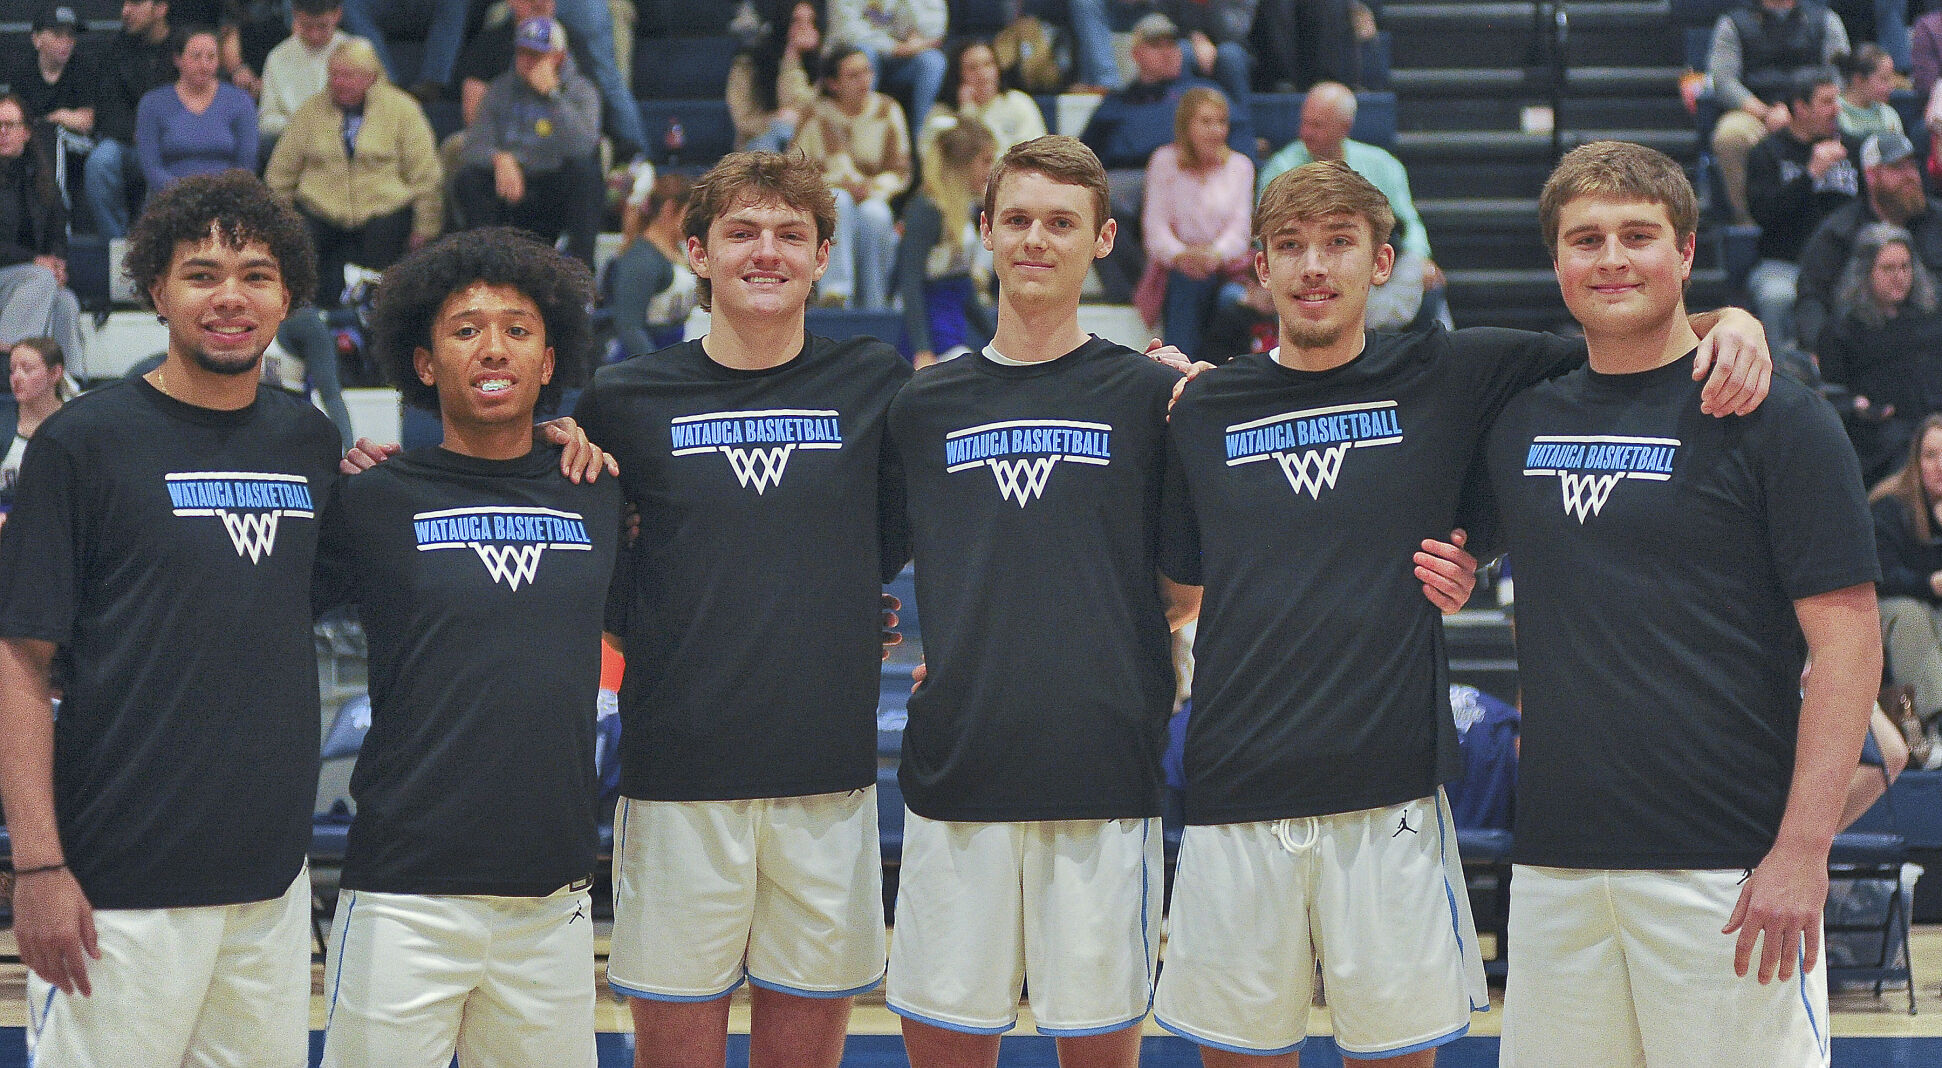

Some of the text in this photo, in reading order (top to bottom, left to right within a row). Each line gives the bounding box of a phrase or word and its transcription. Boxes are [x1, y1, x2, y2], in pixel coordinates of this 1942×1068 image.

[671, 418, 842, 448] WATAUGA BASKETBALL
[946, 428, 1111, 465] WATAUGA BASKETBALL
[1225, 409, 1403, 458] WATAUGA BASKETBALL
[1526, 444, 1676, 472] WATAUGA BASKETBALL
[166, 482, 314, 510] WATAUGA BASKETBALL
[413, 516, 591, 543] WATAUGA BASKETBALL
